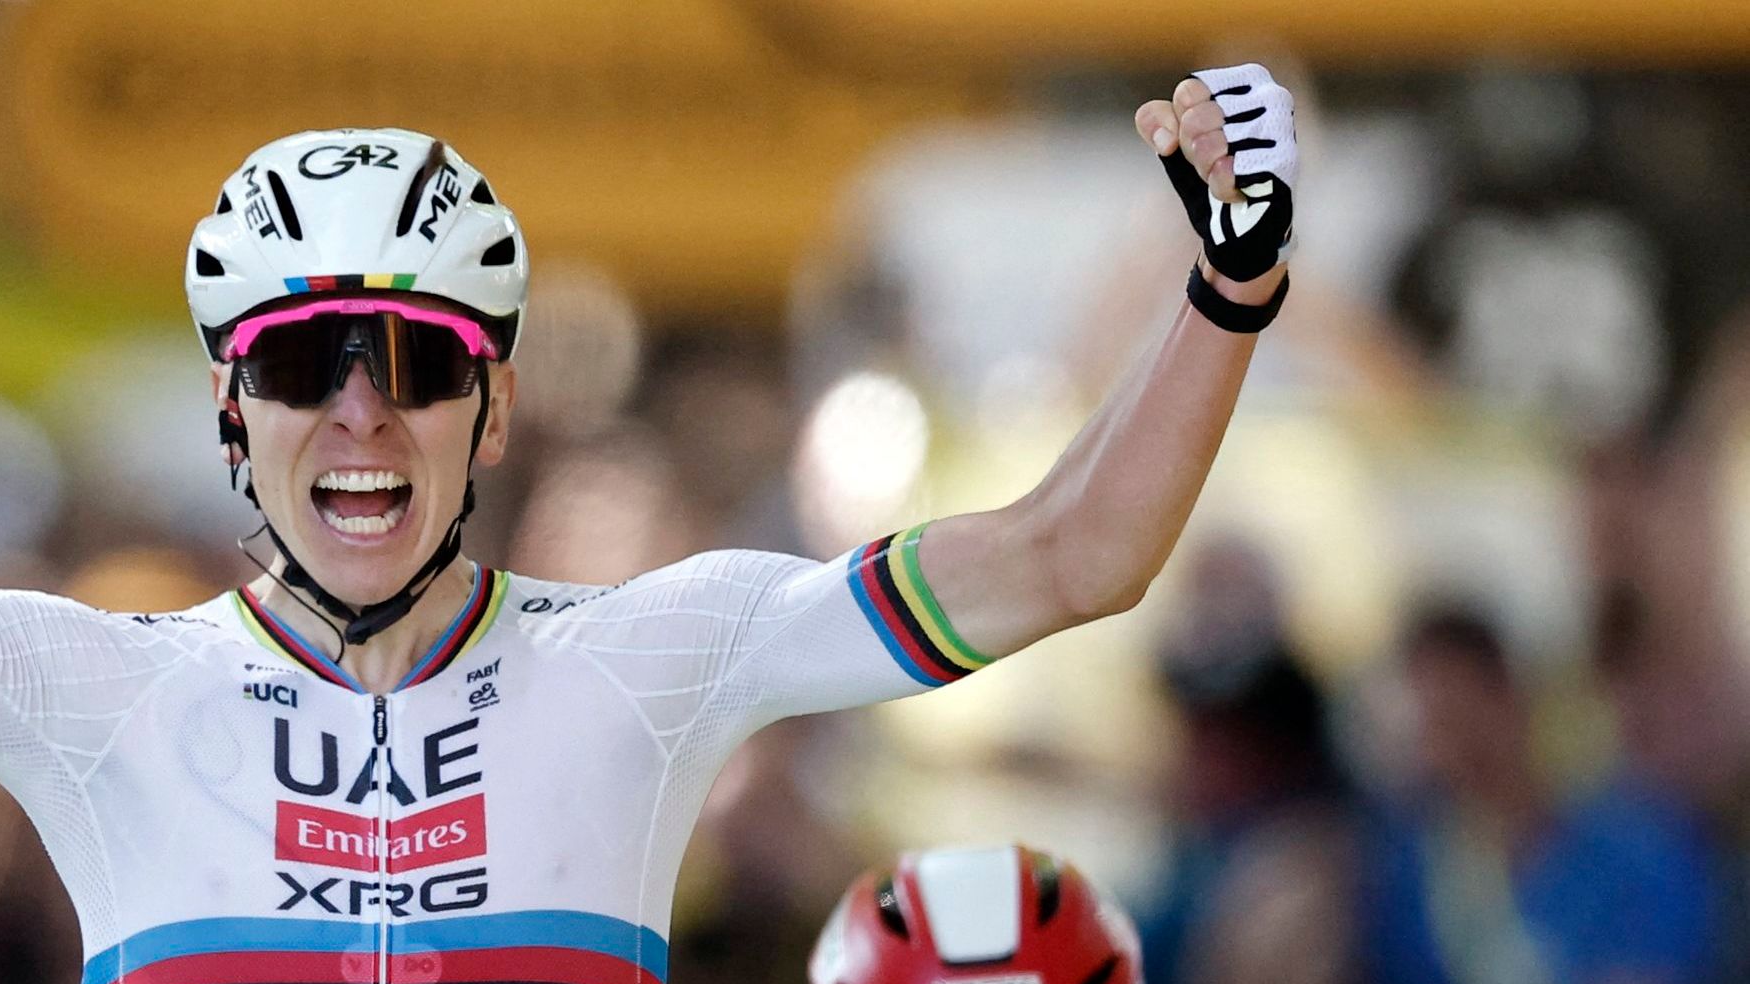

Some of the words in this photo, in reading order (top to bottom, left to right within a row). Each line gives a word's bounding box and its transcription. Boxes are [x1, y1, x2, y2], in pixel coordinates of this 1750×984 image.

[299, 144, 399, 180] G42
[242, 164, 282, 241] MET
[418, 162, 463, 243] MET
[253, 683, 298, 709] UCI
[274, 717, 482, 807] UAE
[297, 818, 467, 859] Emirates
[276, 867, 488, 917] XRG
